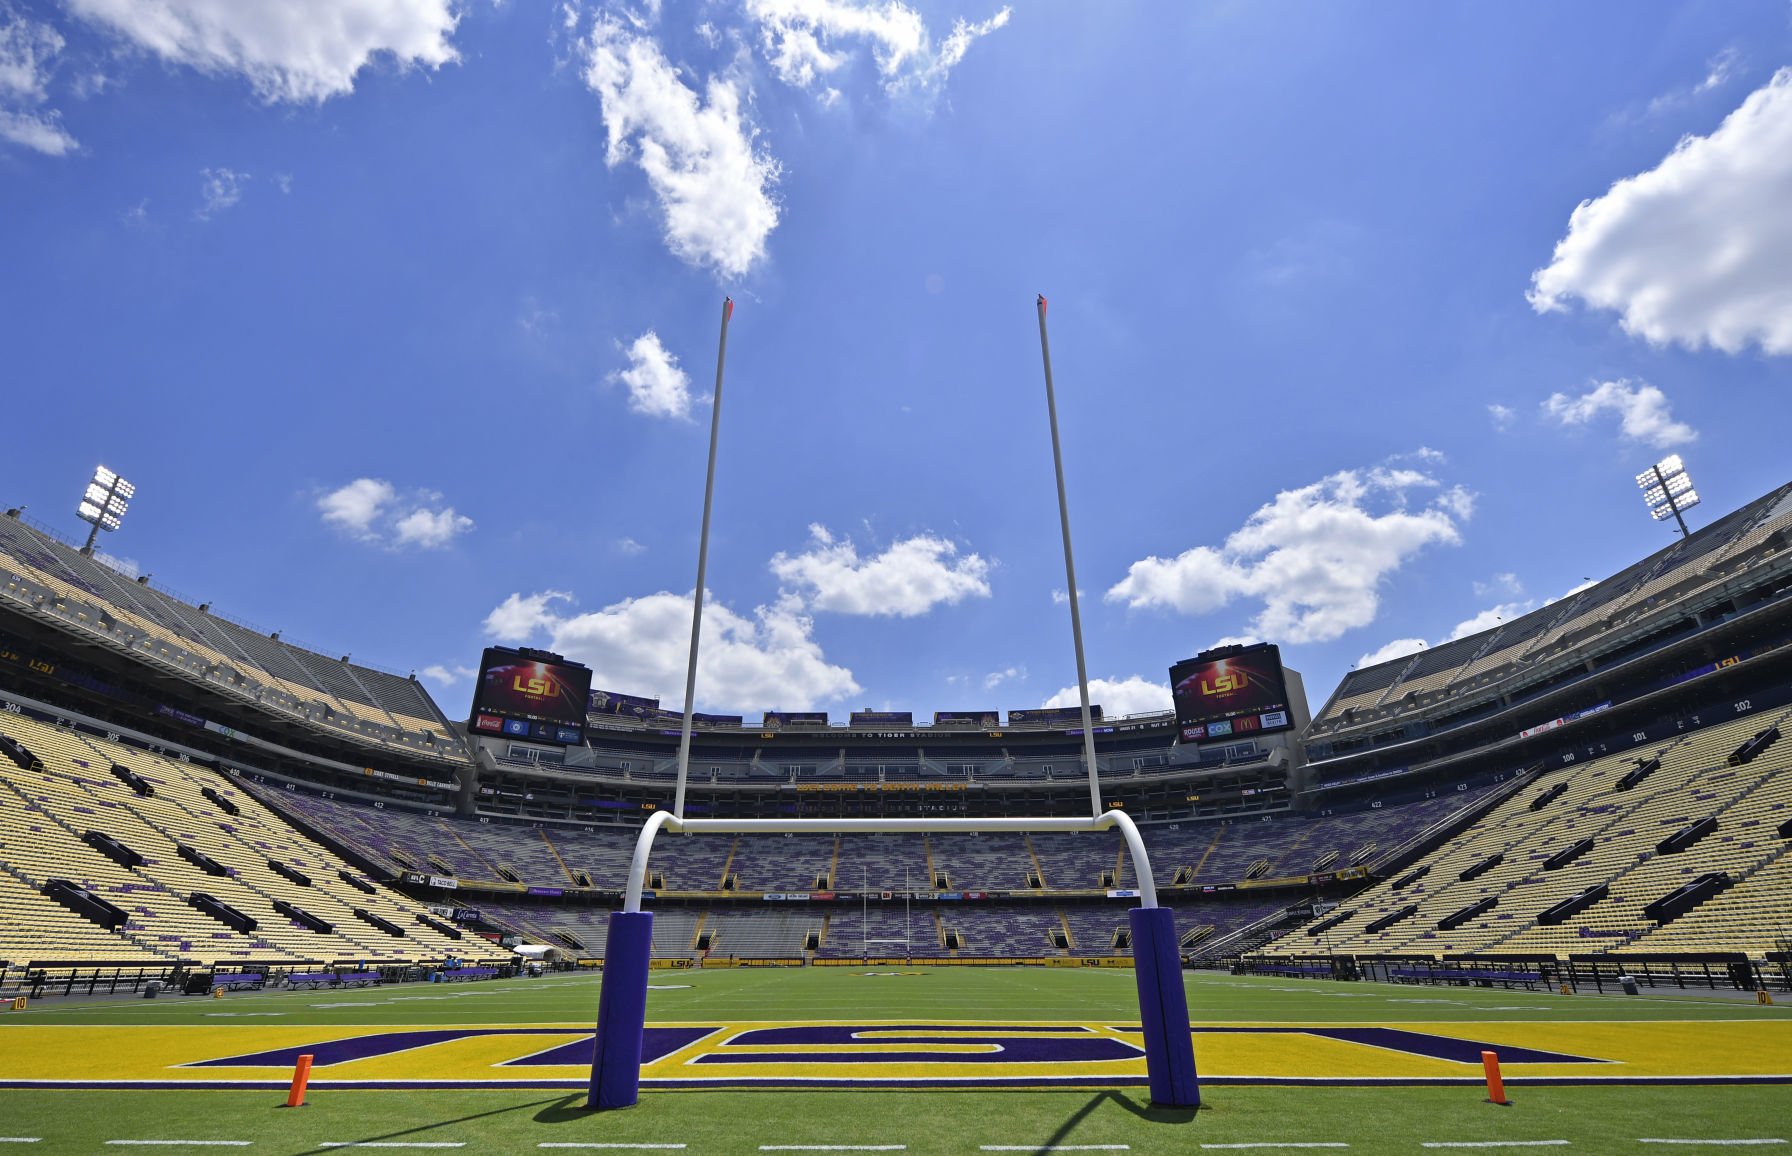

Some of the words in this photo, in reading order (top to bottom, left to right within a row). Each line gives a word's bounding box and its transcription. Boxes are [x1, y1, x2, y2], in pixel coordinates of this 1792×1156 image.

[29, 659, 55, 675] LSU
[1714, 655, 1740, 670] LSU
[512, 675, 561, 697] LSU
[1201, 671, 1249, 696] LSU
[5, 701, 21, 713] 304
[1734, 700, 1752, 712] 102
[1183, 726, 1205, 736] ROUSES
[1208, 723, 1232, 734] COX
[107, 731, 120, 742] 305
[1633, 731, 1647, 742] 101
[1562, 753, 1575, 763] 100
[796, 783, 858, 791] WELCOME
[863, 783, 878, 791] TO
[881, 783, 920, 791] DEATH
[924, 783, 968, 791] VALLEY
[374, 801, 384, 809] 412
[671, 959, 690, 968] LSU
[16, 997, 26, 1009] 10
[1757, 991, 1767, 1004] 10
